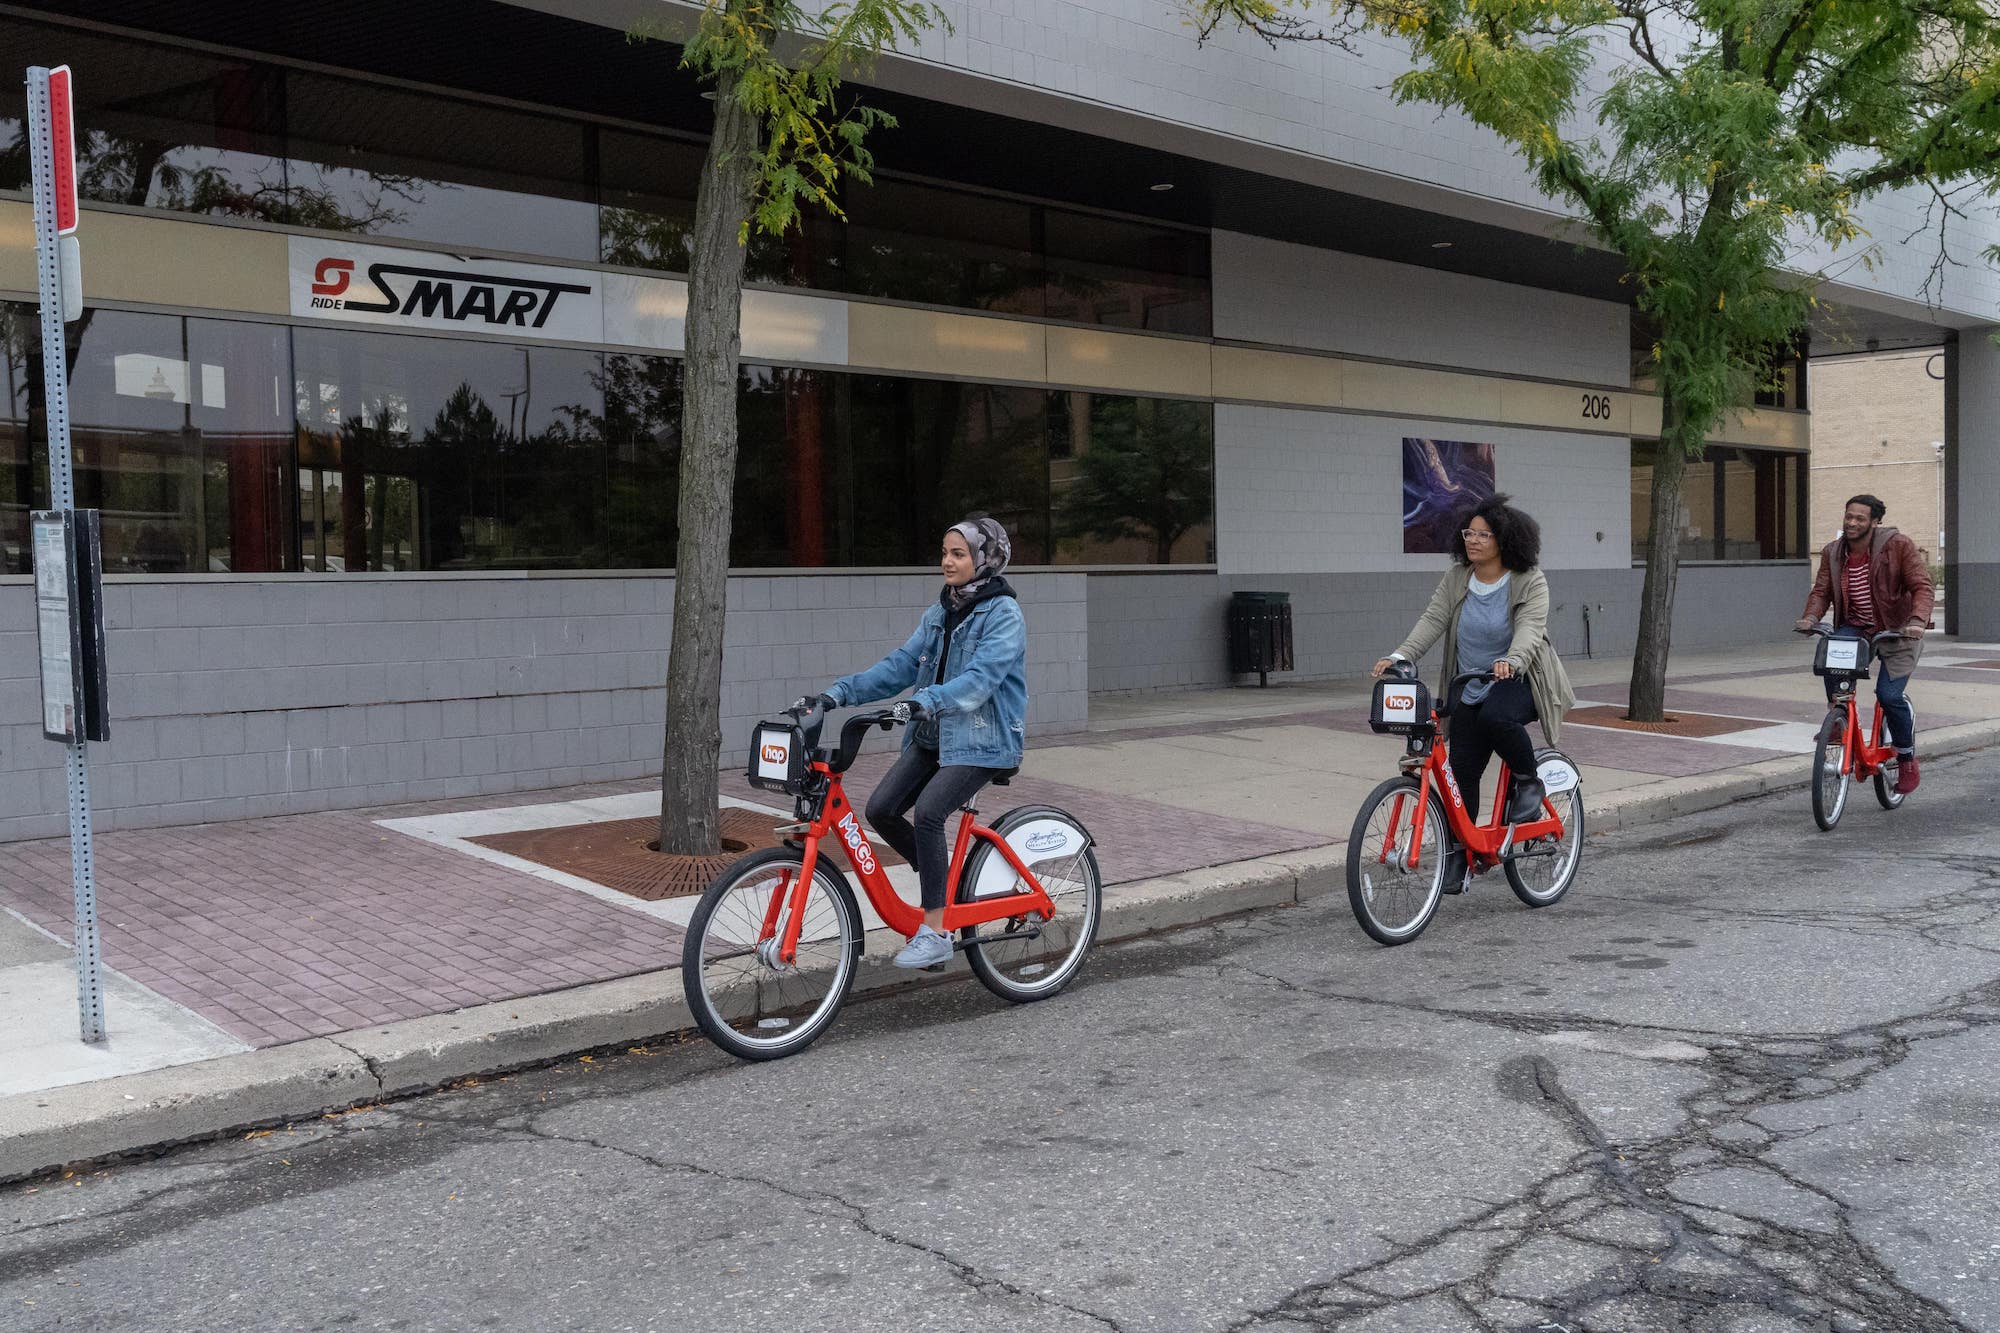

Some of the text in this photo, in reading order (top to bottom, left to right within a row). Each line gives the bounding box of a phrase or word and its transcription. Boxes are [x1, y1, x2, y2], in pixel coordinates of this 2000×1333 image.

[311, 263, 592, 328] RIDE SMART
[1582, 394, 1611, 420] 206
[1389, 695, 1411, 711] hap
[765, 744, 785, 764] hap
